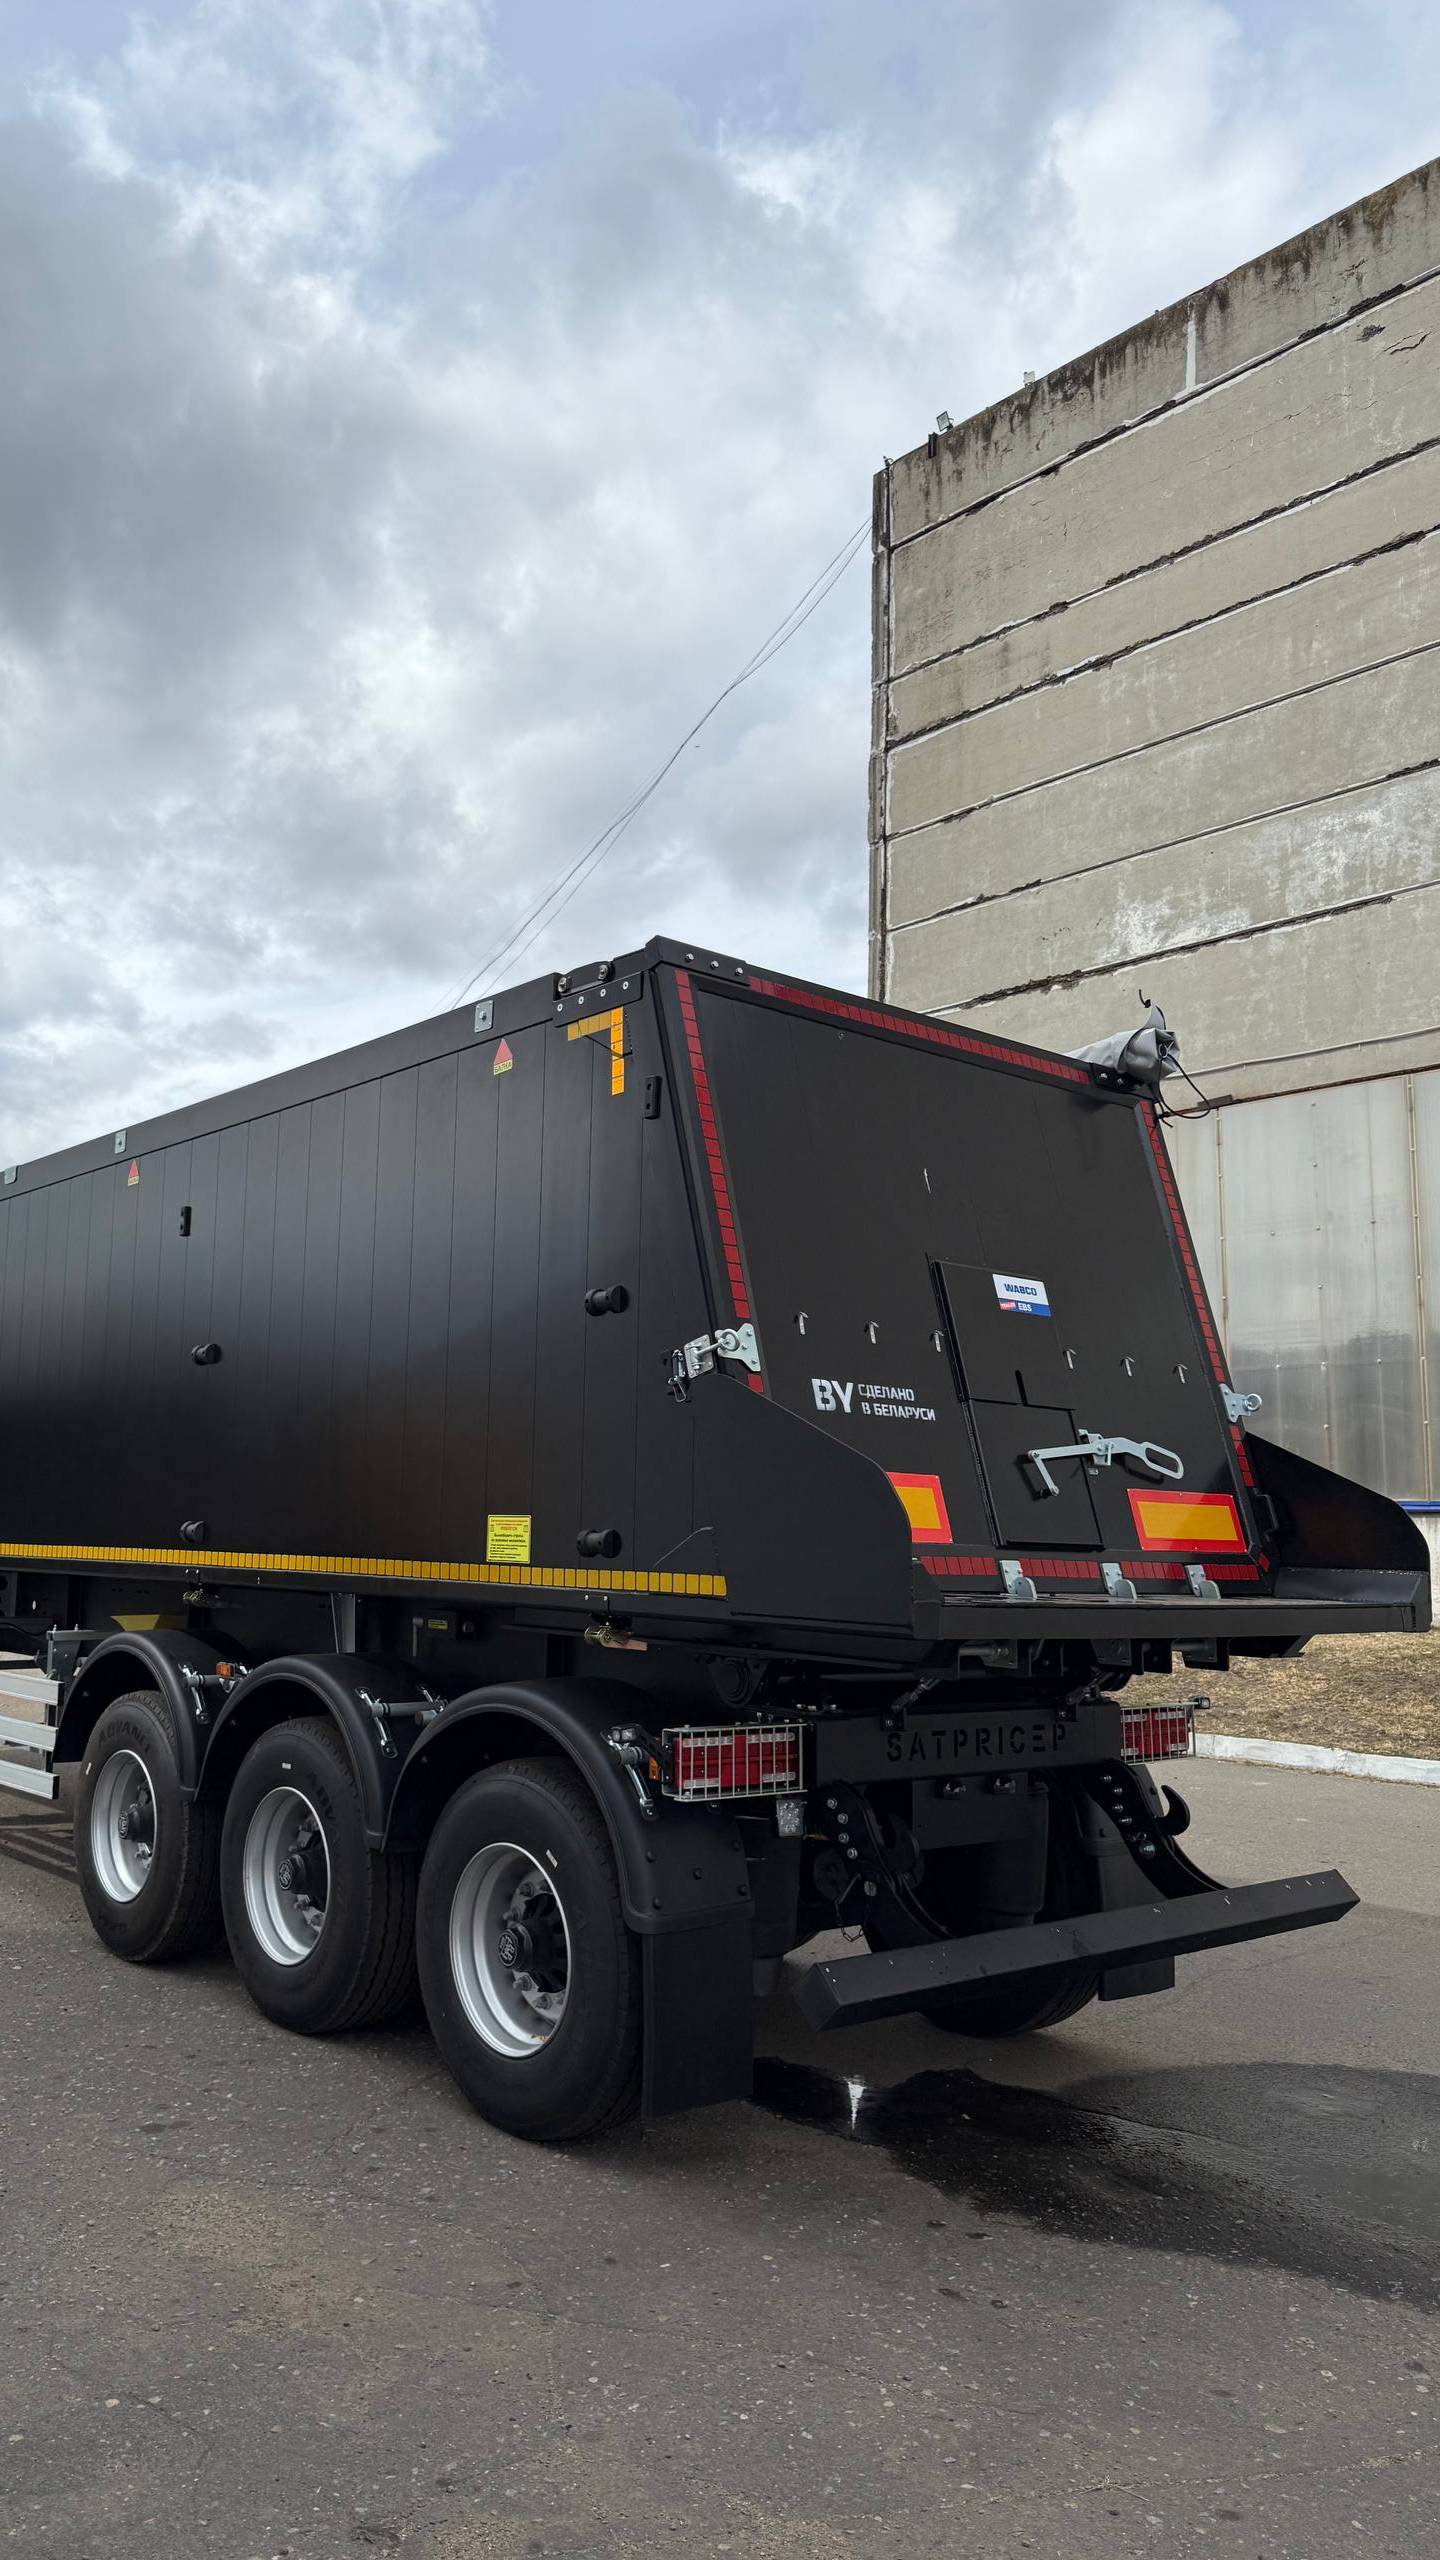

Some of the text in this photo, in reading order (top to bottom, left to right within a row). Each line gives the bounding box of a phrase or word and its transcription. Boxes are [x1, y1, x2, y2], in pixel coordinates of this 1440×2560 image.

[1004, 1283, 1037, 1296] WABCO
[1018, 1302, 1032, 1312] EBS
[811, 1378, 854, 1413] BY
[858, 1383, 915, 1401] СДЕЛАНО
[862, 1402, 936, 1421] В БЕЛАРУСИ
[887, 1723, 1066, 1762] SATPRICEP
